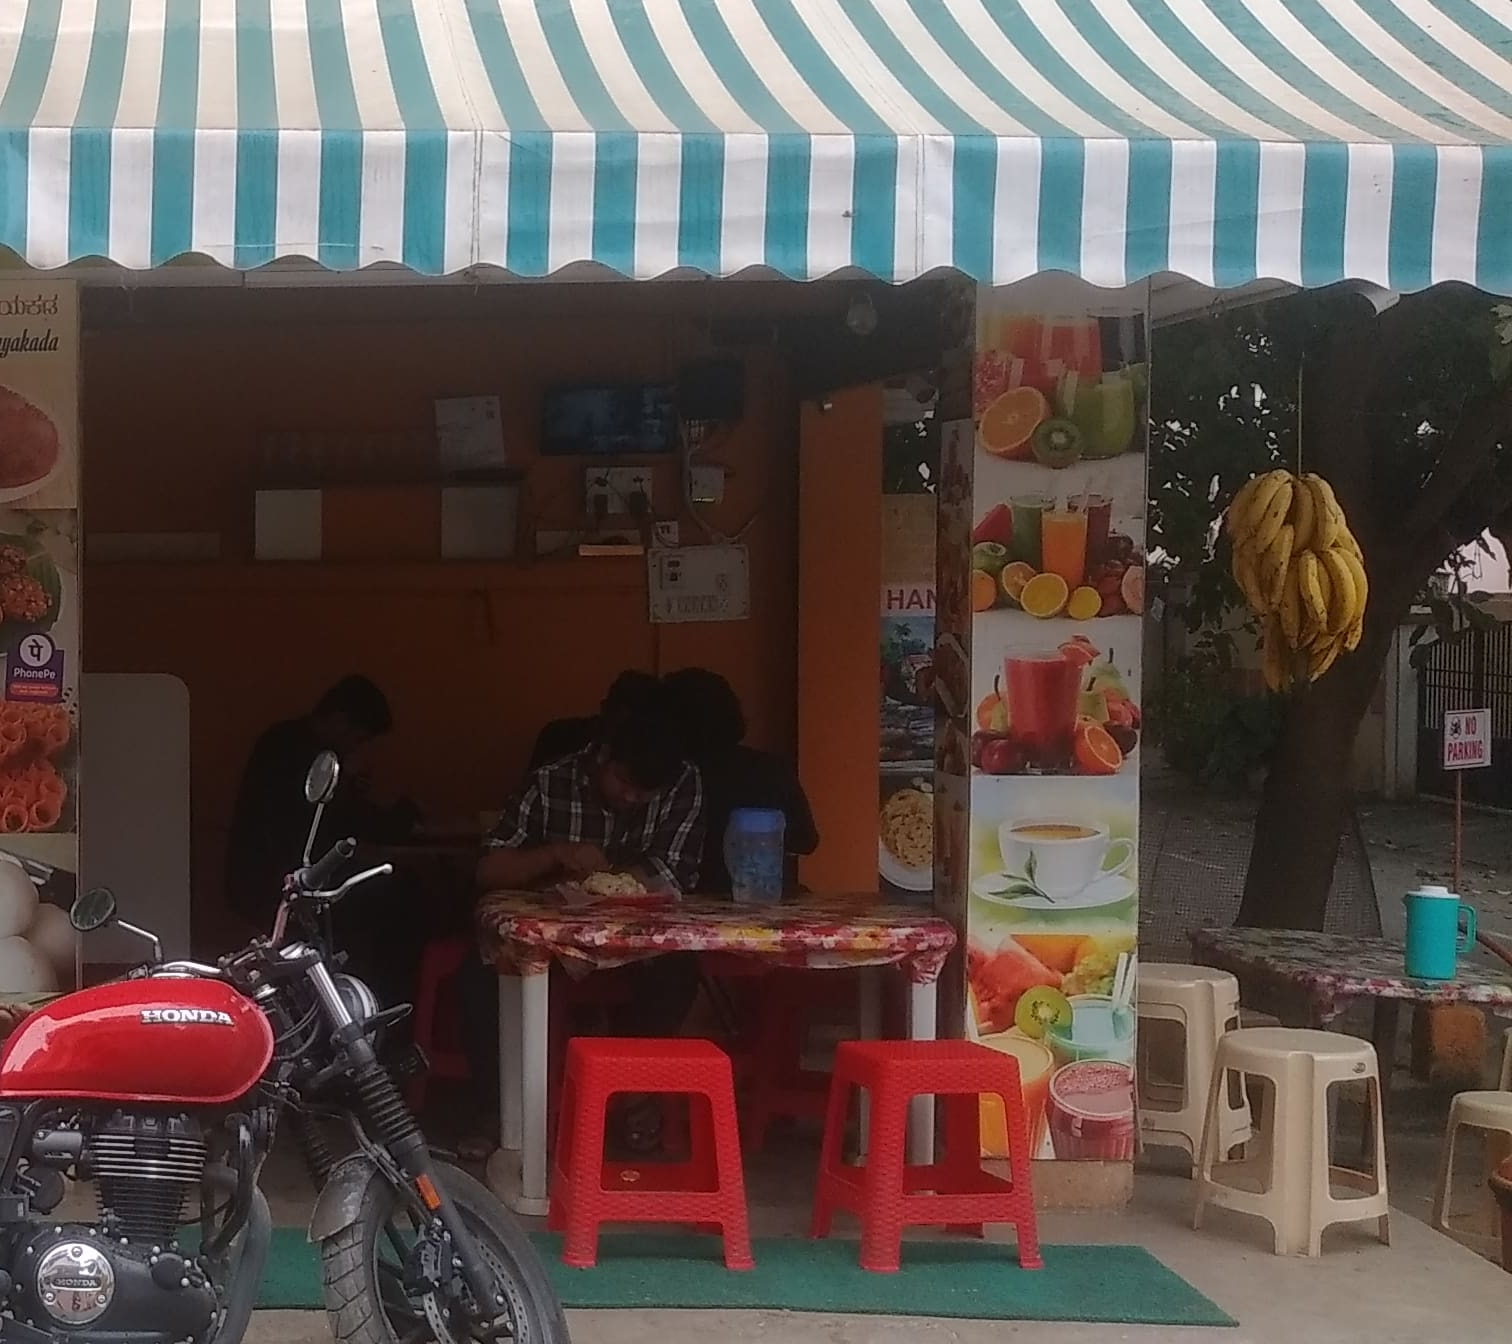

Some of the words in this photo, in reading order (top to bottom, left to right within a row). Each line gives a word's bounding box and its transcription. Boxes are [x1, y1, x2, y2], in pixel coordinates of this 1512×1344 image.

[13, 667, 56, 679] PhonePe
[1464, 715, 1477, 736] NO
[1447, 740, 1483, 762] PARKING
[141, 1009, 234, 1026] HONDA
[54, 1278, 98, 1287] HONDA
